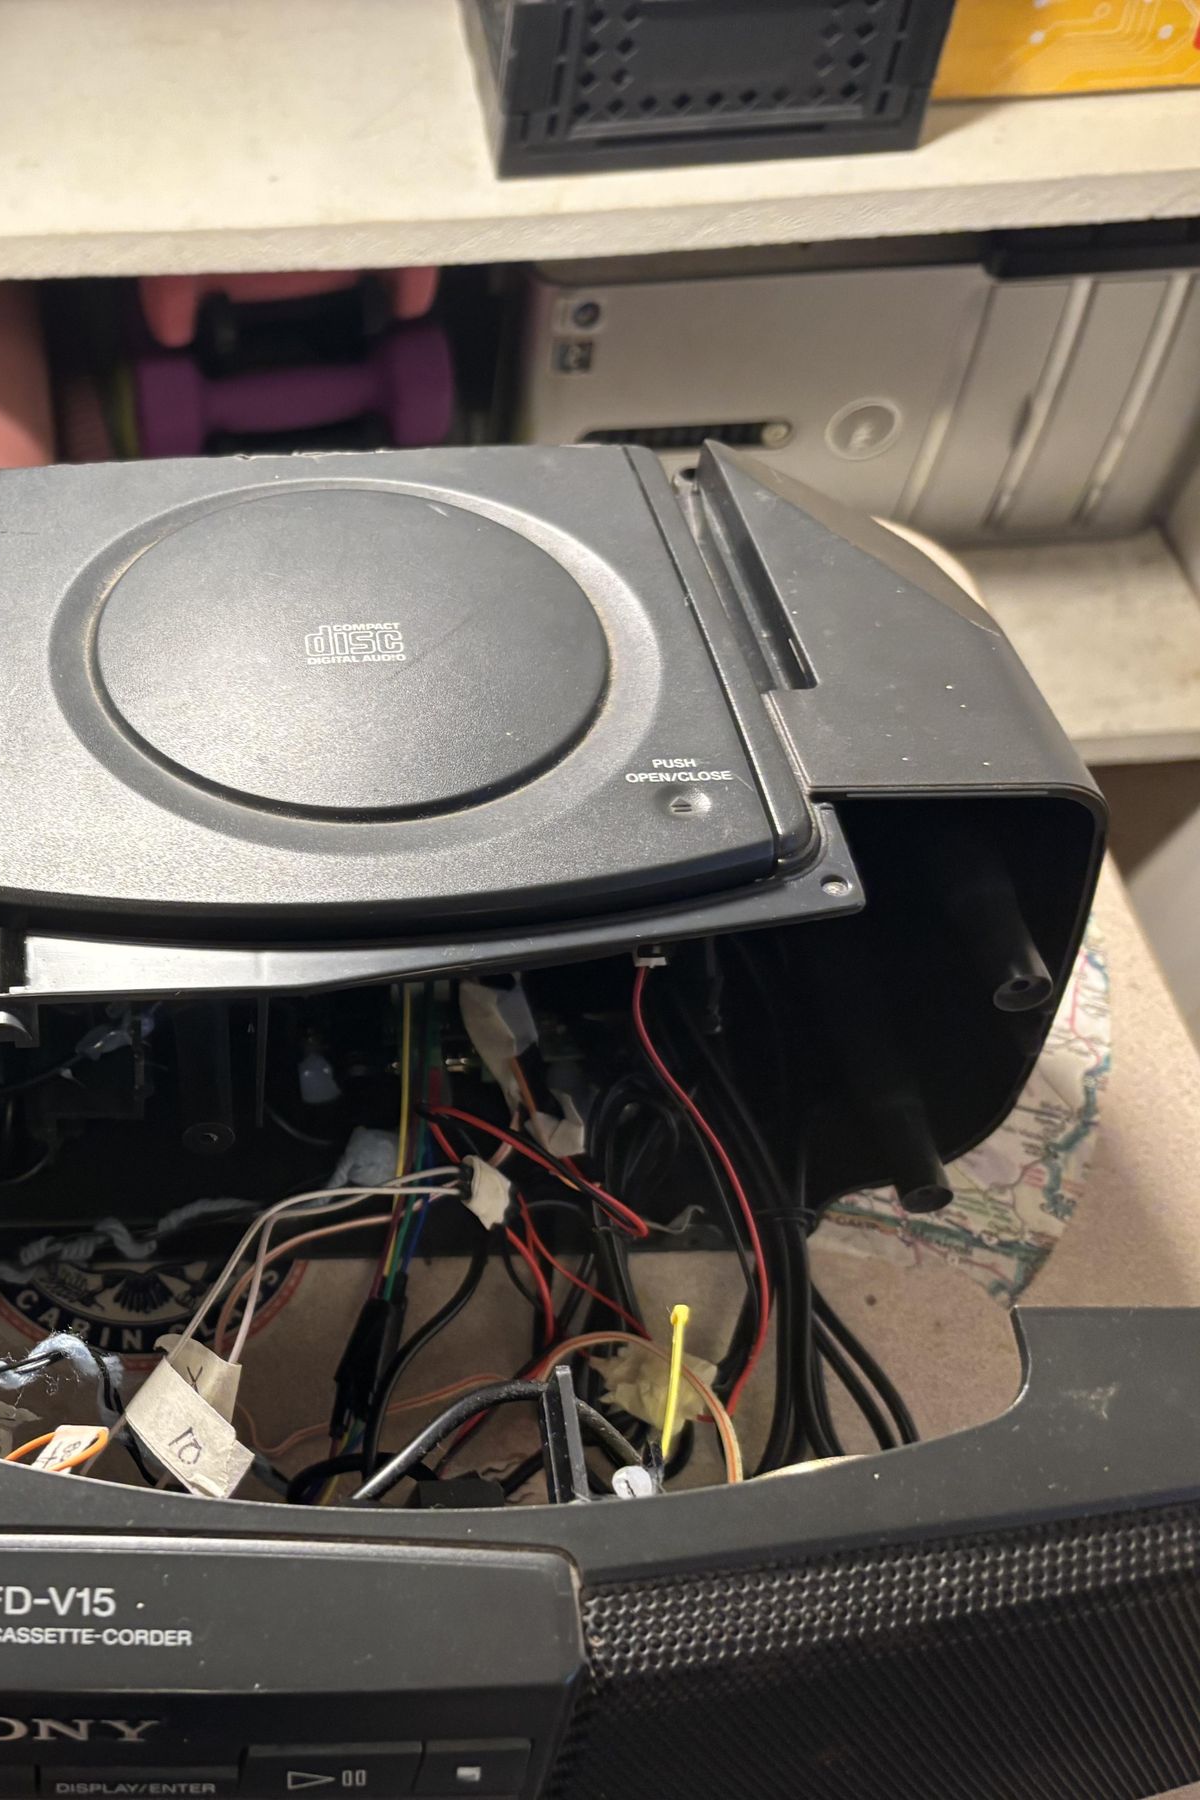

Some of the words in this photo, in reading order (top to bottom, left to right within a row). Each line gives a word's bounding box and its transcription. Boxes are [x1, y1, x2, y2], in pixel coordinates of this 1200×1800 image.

[333, 623, 400, 631] COMPACT
[305, 625, 404, 657] disc
[307, 656, 359, 665] DIGITAL
[362, 654, 406, 662] AUDIO
[652, 758, 696, 769] PUSH
[625, 770, 733, 783] OPEN/CLOSE
[55, 1782, 216, 1795] DISPLAY/ENTER
